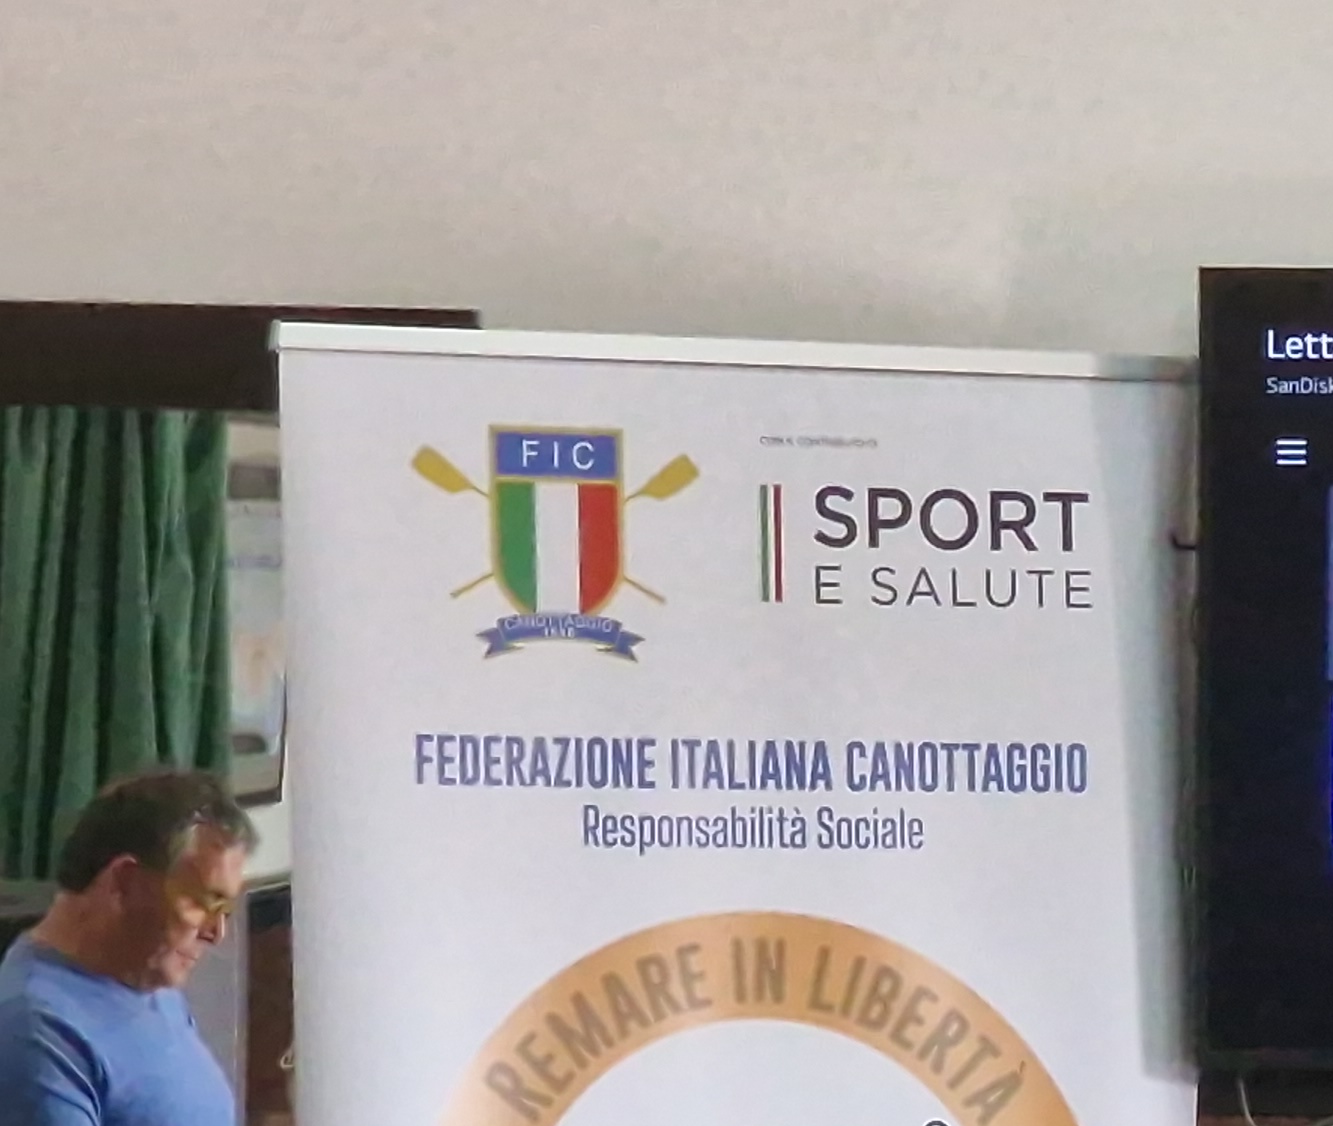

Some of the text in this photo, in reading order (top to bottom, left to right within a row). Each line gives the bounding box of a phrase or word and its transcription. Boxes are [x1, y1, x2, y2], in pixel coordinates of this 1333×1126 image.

[812, 485, 1091, 553] SPORT
[814, 565, 1094, 610] E SALUTE
[413, 734, 1088, 795] FEDERAZIONE ITALIANA CANOTTAGGIO
[583, 805, 925, 857] Responsabilità Sociale
[484, 942, 714, 1126] REMARE
[731, 937, 787, 1006] IN
